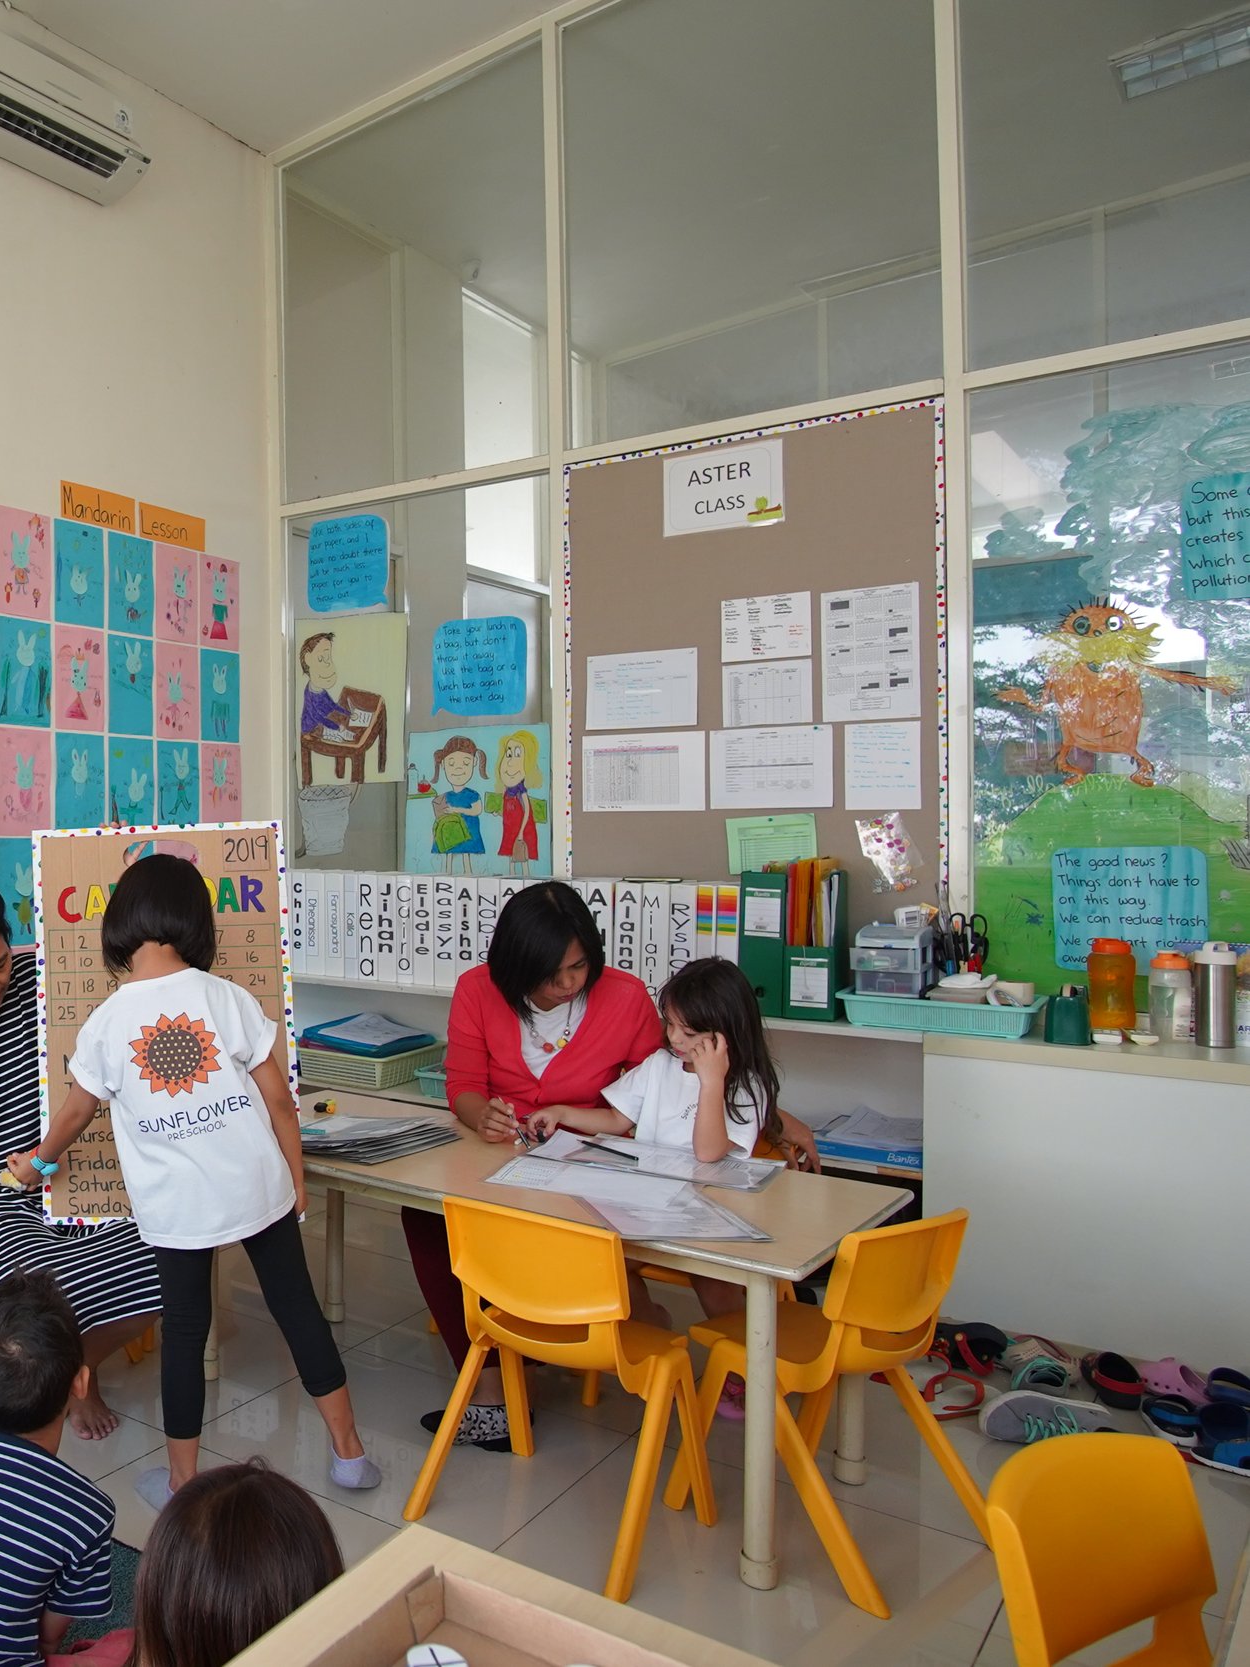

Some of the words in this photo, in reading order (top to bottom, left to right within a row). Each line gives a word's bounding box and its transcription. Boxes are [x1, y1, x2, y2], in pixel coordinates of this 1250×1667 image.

[687, 461, 751, 487] ASTER
[1191, 481, 1239, 504] Some
[63, 485, 131, 531] Mandarin
[140, 508, 188, 542] Lesson
[694, 494, 745, 515] CLASS
[326, 524, 342, 534] both
[344, 520, 361, 529] sides
[365, 519, 375, 530] of
[1185, 510, 1213, 526] but
[347, 535, 359, 544] and
[1185, 529, 1244, 548] creates
[339, 551, 360, 560] doubt
[363, 547, 383, 557] there
[1188, 553, 1236, 570] which
[333, 565, 350, 573] much
[354, 561, 366, 569] less
[311, 581, 328, 591] paper
[333, 578, 343, 589] for
[347, 576, 360, 586] you
[315, 594, 334, 604] throw
[337, 590, 350, 598] out
[442, 625, 461, 635] Take
[465, 626, 481, 636] your
[486, 620, 506, 631] lunch
[464, 638, 479, 647] but
[482, 636, 507, 646] don't
[436, 655, 459, 664] throw
[460, 665, 473, 673] the
[477, 664, 494, 676] bag
[510, 663, 517, 671] a
[437, 681, 459, 692] lunch
[462, 680, 476, 689] box
[479, 678, 504, 690] again
[448, 695, 462, 703] the
[465, 693, 483, 702] next
[487, 692, 505, 703] day
[223, 834, 269, 864] 2019
[1055, 851, 1081, 869] The
[1088, 855, 1120, 871] good
[1125, 857, 1156, 867] news
[1057, 874, 1101, 892] Things
[1108, 875, 1142, 888] don't
[1148, 873, 1179, 887] have
[1182, 874, 1200, 887] to
[57, 874, 267, 924] CAAR
[1058, 895, 1076, 904] on
[1084, 893, 1110, 906] this
[293, 882, 302, 949] Chloe
[378, 882, 394, 953] Jihan
[415, 883, 430, 955] Elodie
[435, 882, 453, 960] Rassya
[457, 887, 472, 961] Aisha
[1059, 912, 1080, 924] We
[1086, 914, 1111, 925] can
[1118, 913, 1164, 925] reduce
[359, 883, 374, 977] Rena
[396, 885, 411, 971] Cairo
[618, 890, 637, 970] Alanna
[60, 936, 65, 949] 1
[77, 935, 88, 950] 2
[215, 929, 224, 945] 7
[245, 929, 256, 943] 8
[643, 894, 660, 997] Milania
[1059, 935, 1081, 946] We
[57, 956, 67, 970] 9
[79, 957, 93, 968] 10
[245, 951, 259, 963] 16
[56, 981, 71, 995] 17
[82, 978, 95, 993] 18
[106, 979, 118, 992] 19
[248, 973, 266, 986] 24
[58, 1005, 76, 1020] 25
[138, 1095, 252, 1133] SUNFLOWER
[167, 1119, 227, 1142] PRESCHOOL
[67, 1150, 121, 1172] Frida
[886, 1152, 921, 1166] Bantex
[68, 1174, 126, 1194] Satur
[70, 1197, 133, 1216] Sunday
